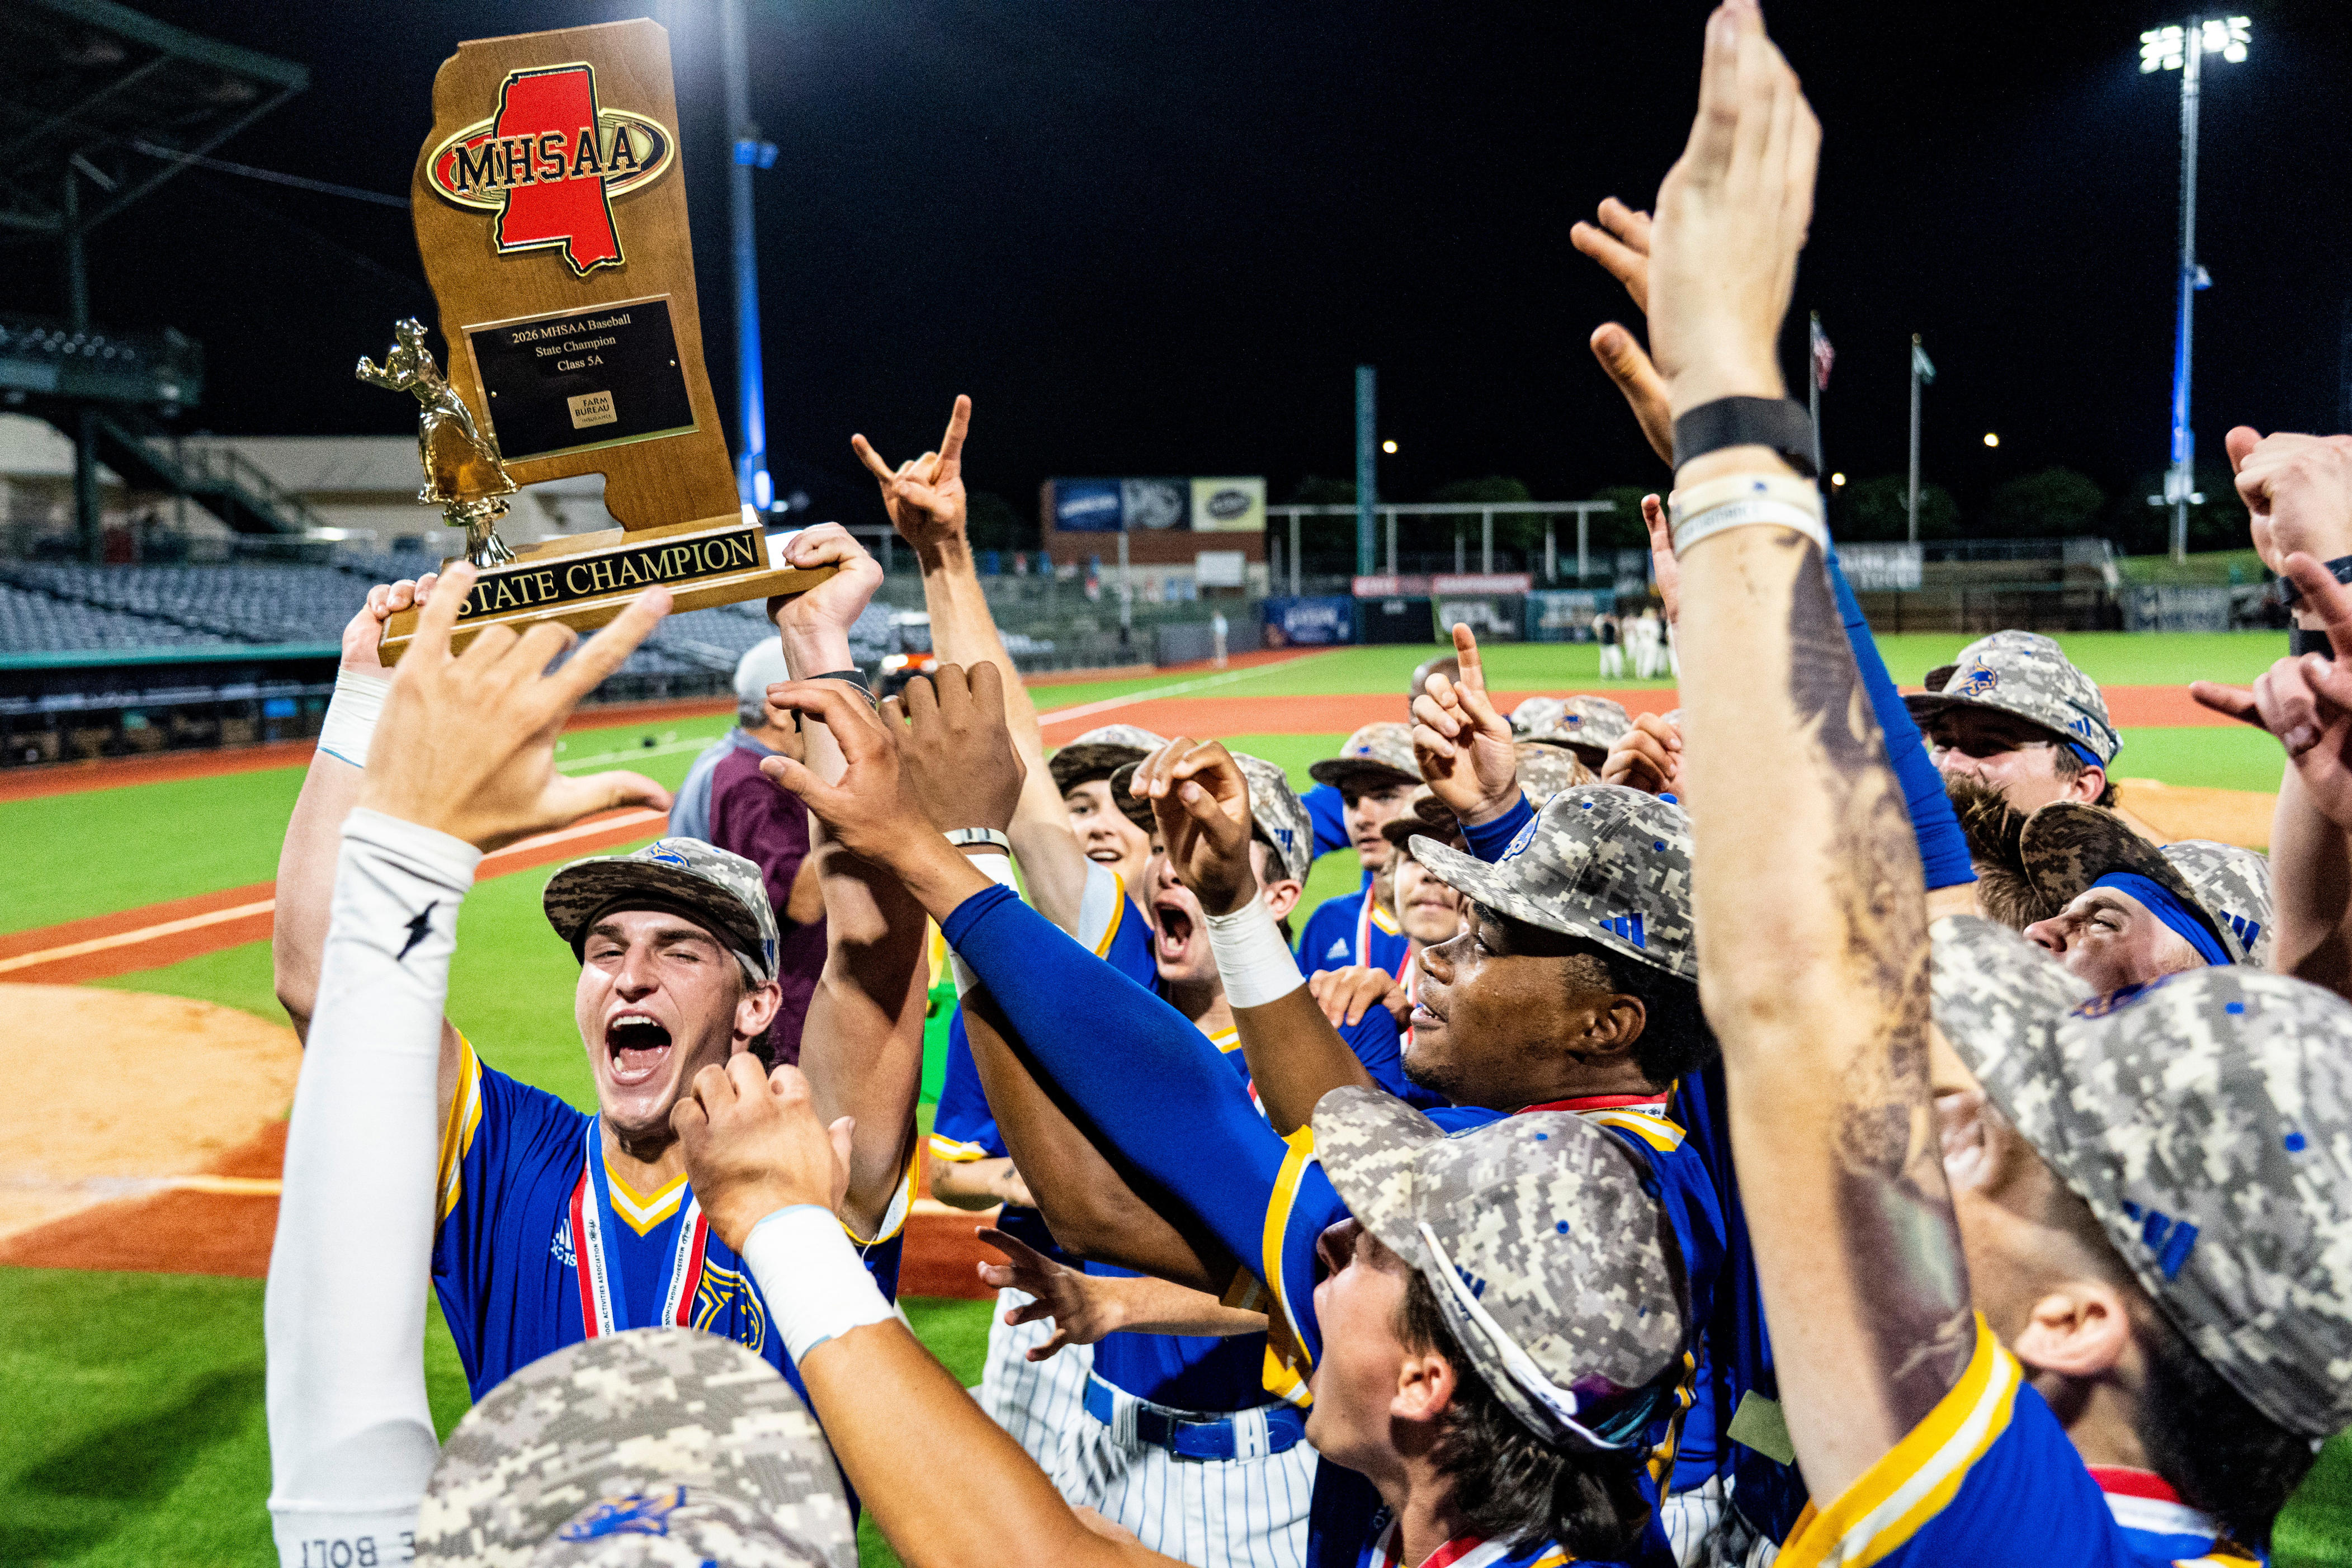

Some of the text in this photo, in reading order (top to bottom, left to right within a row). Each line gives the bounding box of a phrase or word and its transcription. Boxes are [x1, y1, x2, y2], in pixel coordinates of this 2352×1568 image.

[452, 122, 641, 195] MHSAA
[512, 314, 631, 343] 2026 MHSAA Baseball
[536, 337, 616, 357] State Champion
[558, 355, 603, 371] Class 5A
[575, 404, 610, 417] BUREAU
[583, 397, 608, 407] FARM
[566, 535, 754, 595] CHAMPION
[594, 1244, 603, 1283] ASSOCIATION
[674, 1246, 684, 1283] MISSISSIPPI
[599, 1285, 608, 1318] ACTIVITIES
